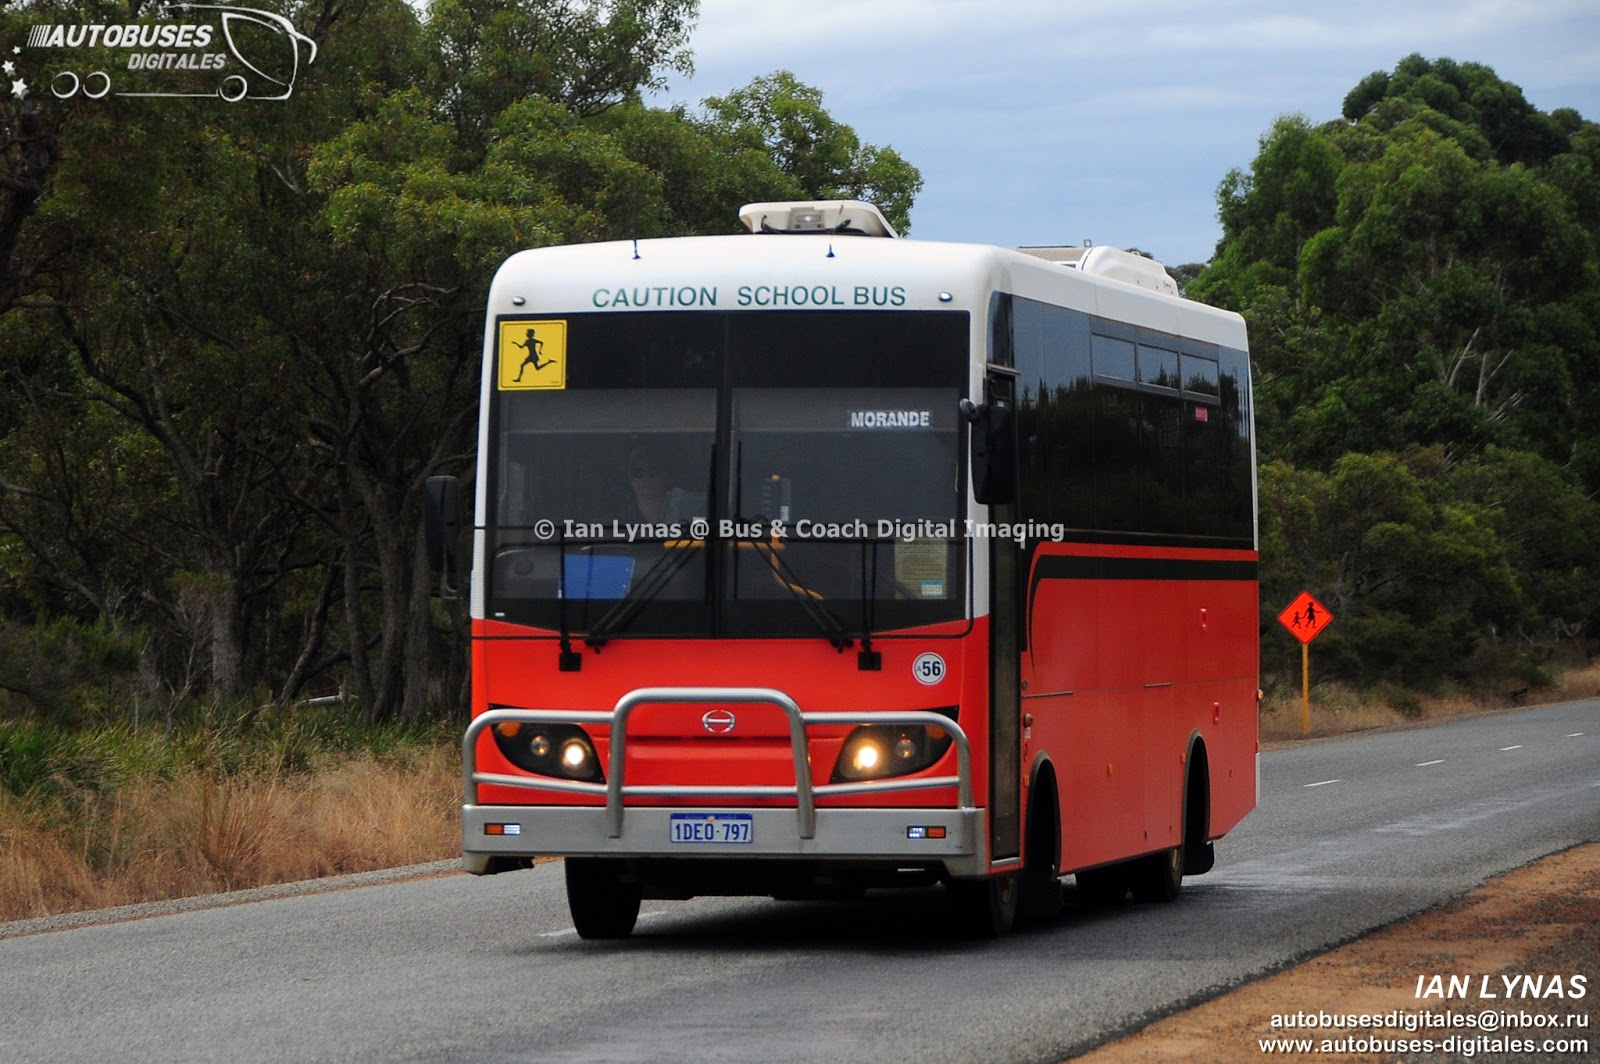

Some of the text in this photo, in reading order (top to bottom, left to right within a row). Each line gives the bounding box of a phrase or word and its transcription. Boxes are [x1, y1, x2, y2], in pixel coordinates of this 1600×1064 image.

[592, 285, 906, 308] CAUTION SCHOOL BUS
[850, 411, 930, 427] MORANDE
[922, 660, 941, 677] 56
